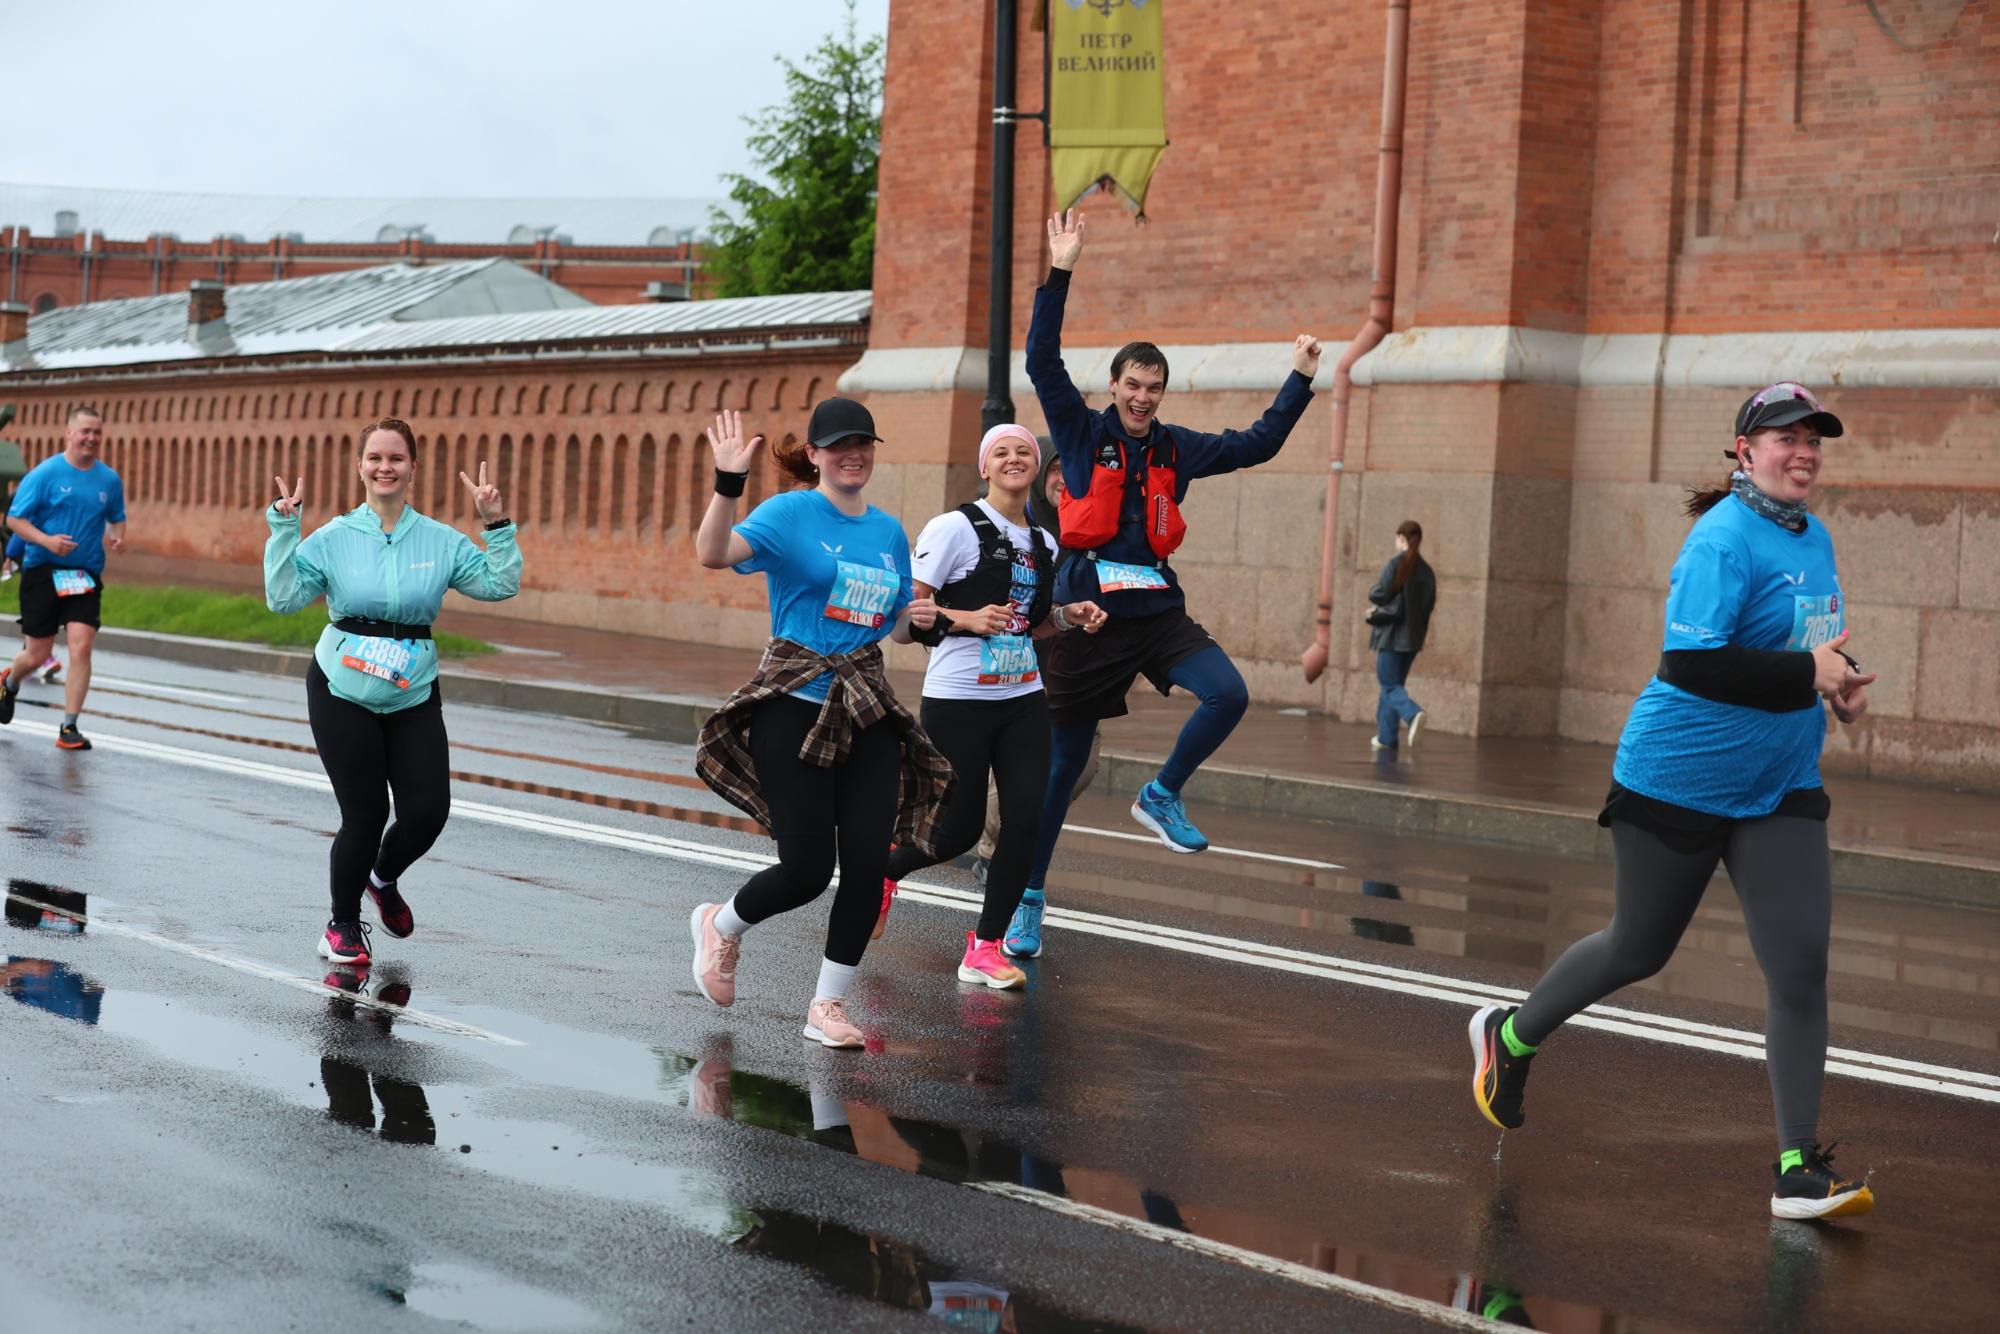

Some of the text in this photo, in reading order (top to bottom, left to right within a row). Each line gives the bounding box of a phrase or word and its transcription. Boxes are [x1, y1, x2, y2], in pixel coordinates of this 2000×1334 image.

[1080, 33, 1132, 48] ПЕТР
[1057, 50, 1156, 72] ВЕЛИКИЙ
[1160, 495, 1169, 537] AONIJIE
[842, 578, 890, 613] 70127
[355, 636, 410, 673] 73896
[990, 647, 1033, 672] 70540
